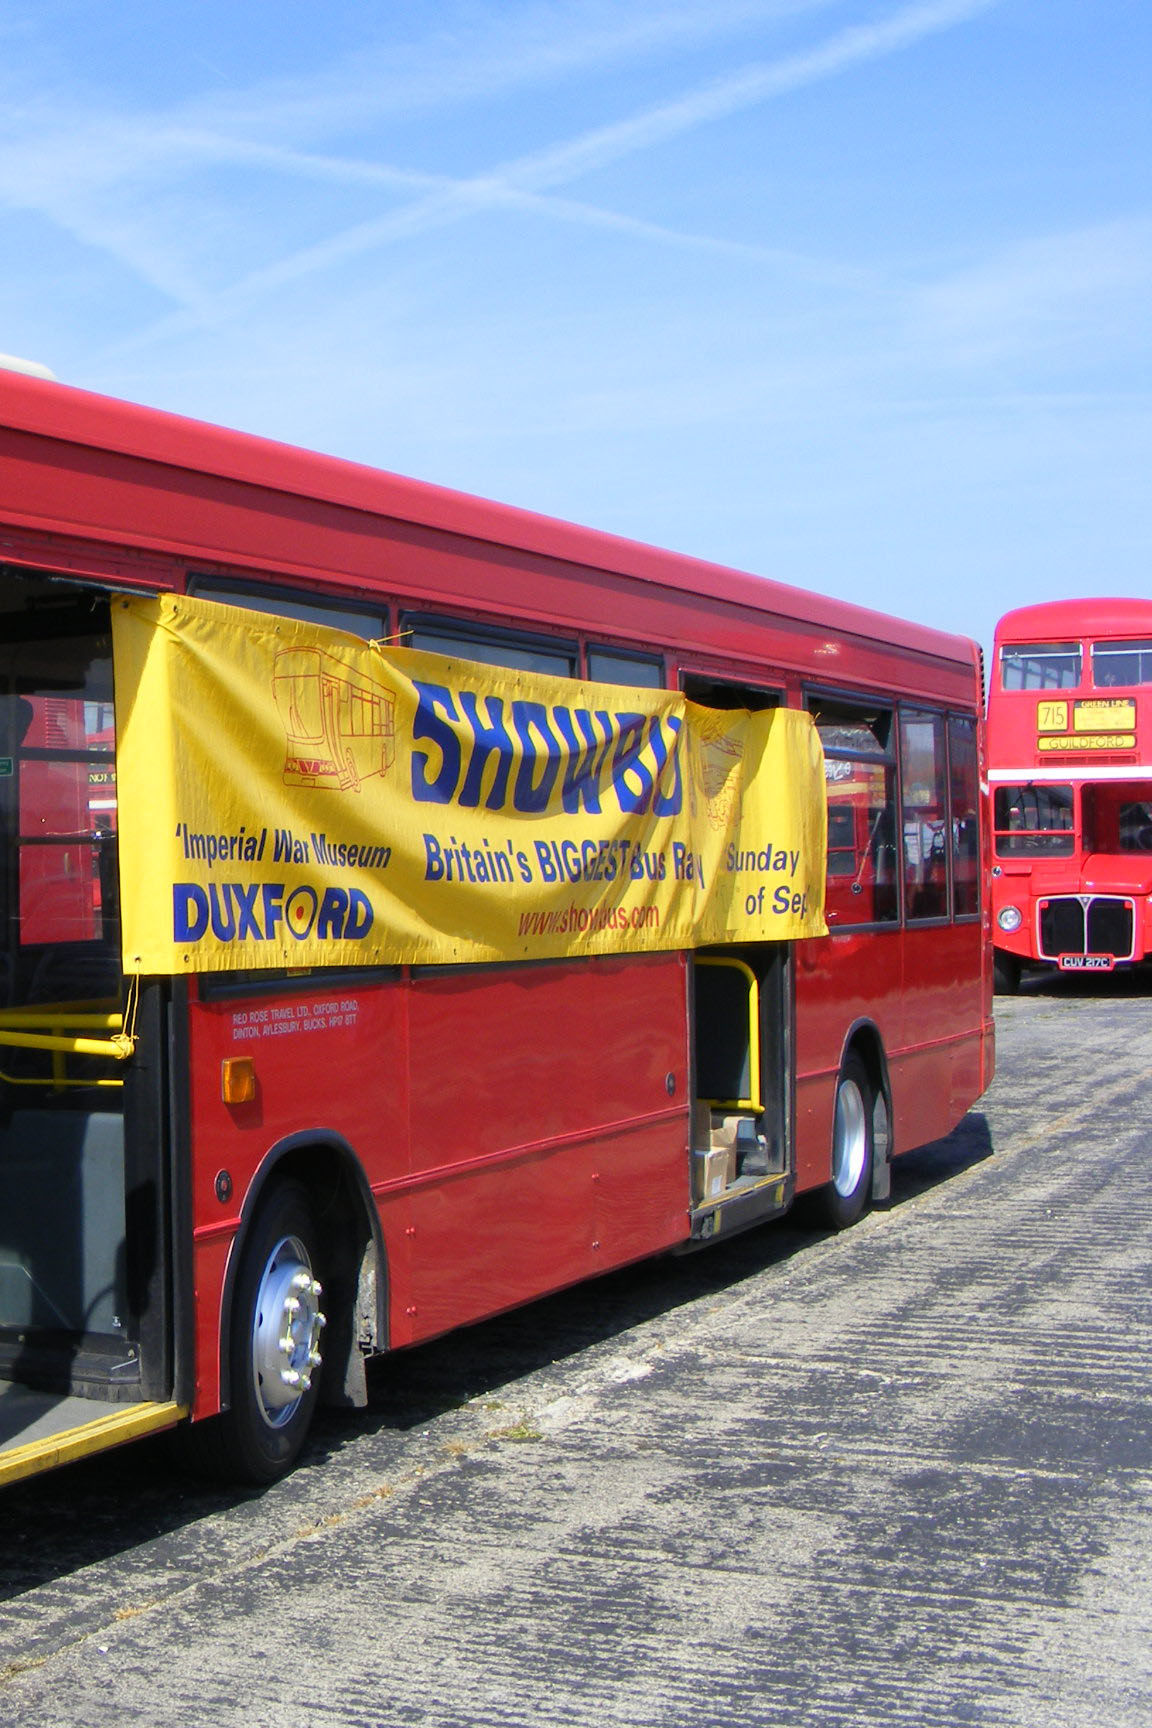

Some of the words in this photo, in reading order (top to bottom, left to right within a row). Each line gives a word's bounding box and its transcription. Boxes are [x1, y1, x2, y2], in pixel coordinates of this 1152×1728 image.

[1041, 706, 1065, 725] 715
[1081, 699, 1110, 708] GREEN
[411, 680, 683, 818] SHOWBU
[1049, 735, 1125, 750] GUILDFORD
[273, 829, 310, 864] War
[311, 833, 392, 868] Museum
[423, 833, 533, 883] Britain's
[534, 840, 631, 884] BIGGEST
[630, 841, 666, 880] Bus
[726, 842, 800, 878] Sunday
[173, 883, 374, 942] DUXFORD
[745, 886, 766, 915] of
[518, 899, 660, 937] www.showbus.com
[1063, 957, 1084, 967] CUV
[1085, 957, 1108, 967] 217C
[232, 1012, 248, 1025] RED
[249, 1010, 268, 1023] ROSE
[270, 1007, 295, 1020] TRAVEL
[313, 1002, 339, 1016] OXFORD
